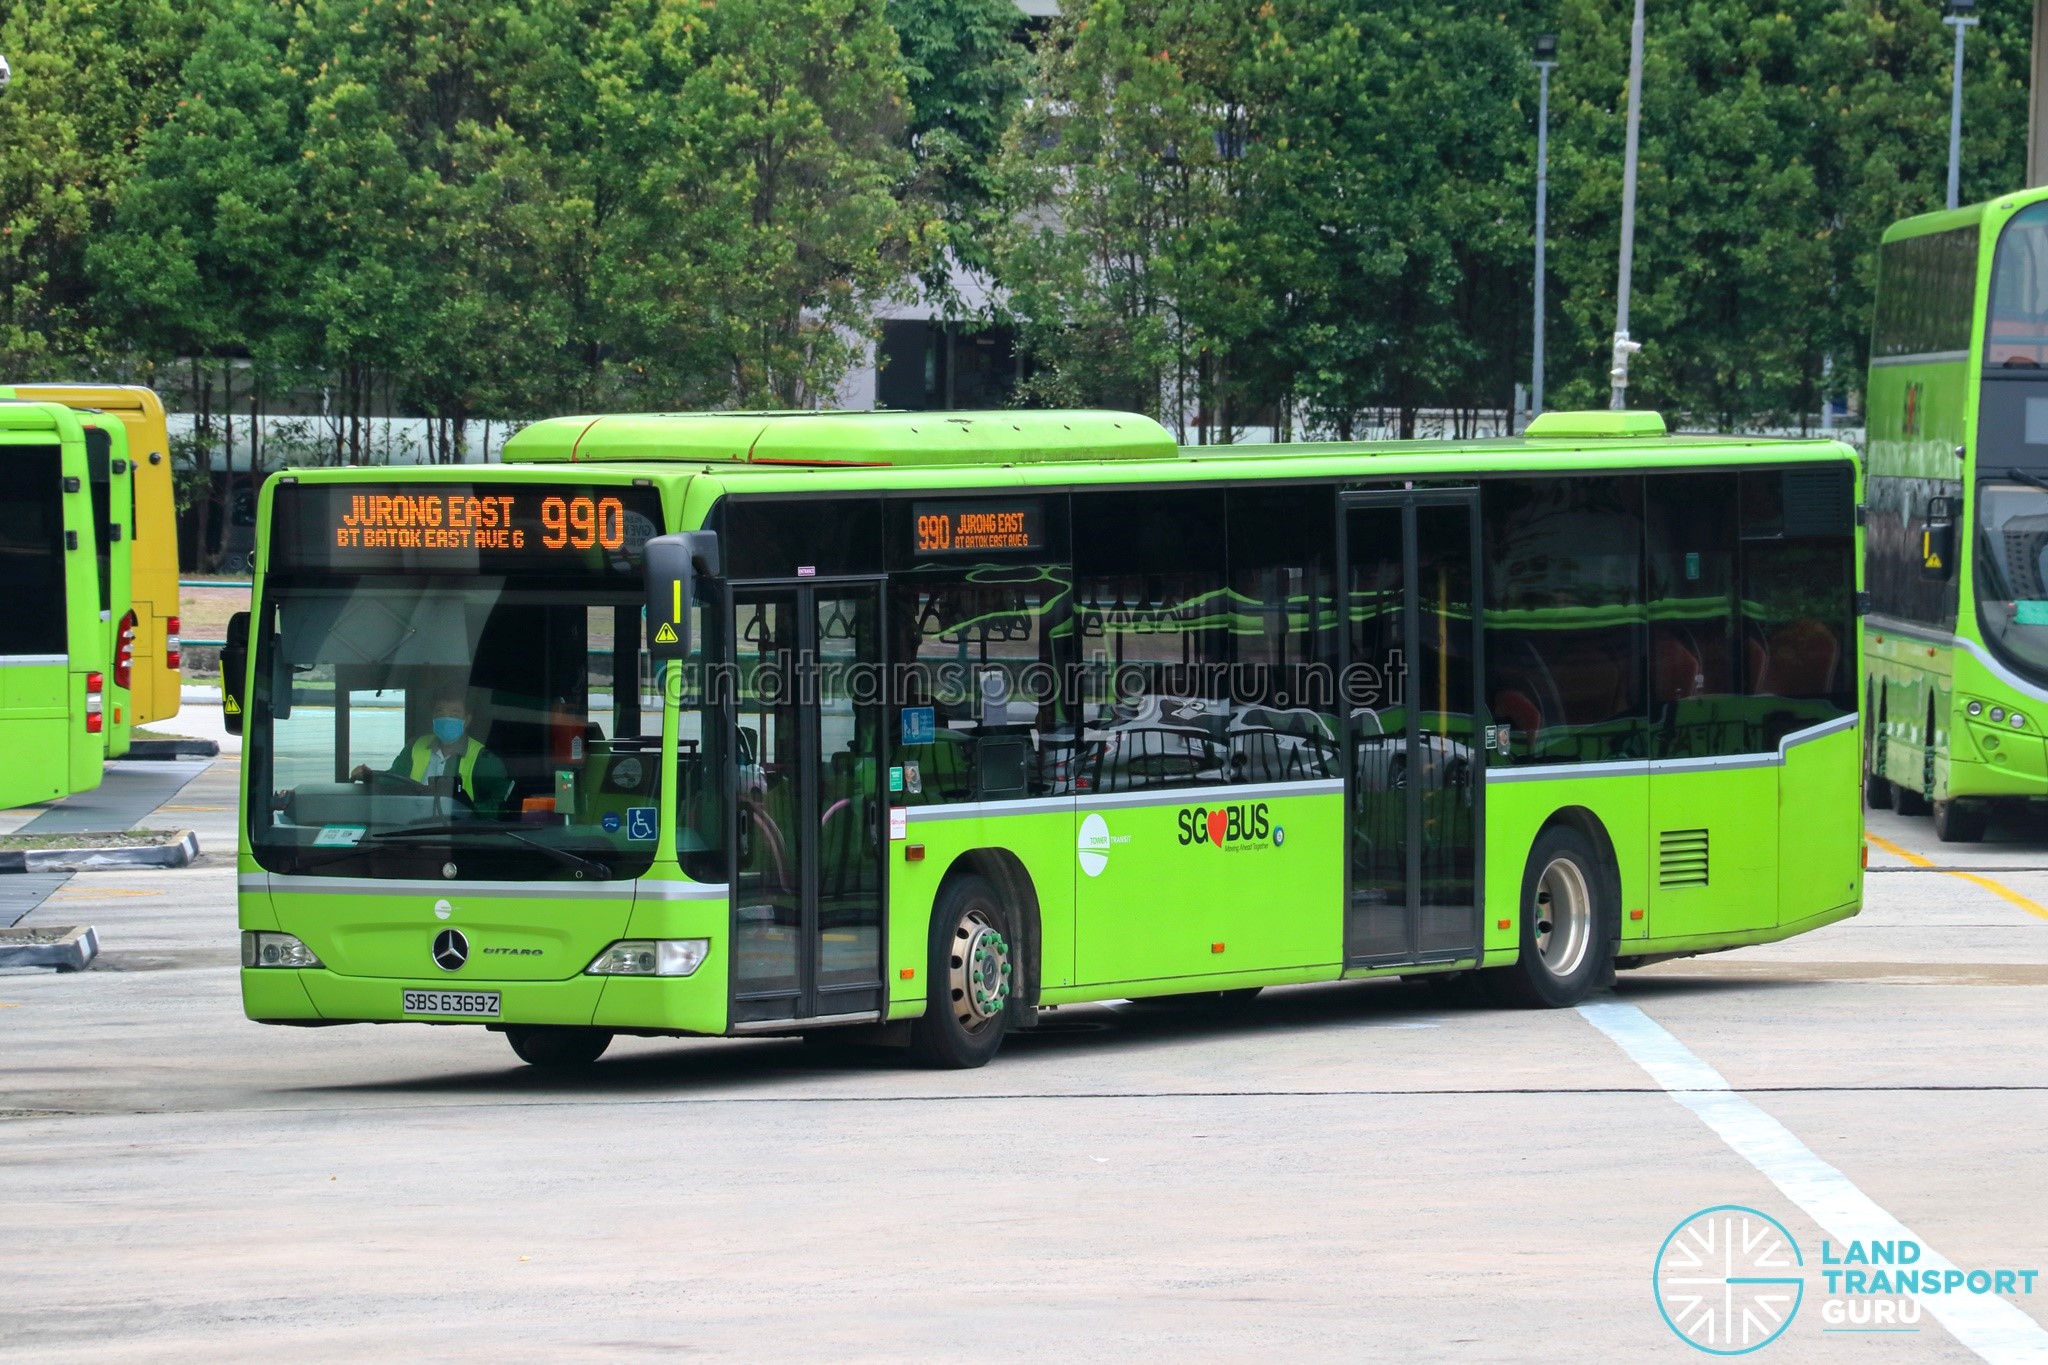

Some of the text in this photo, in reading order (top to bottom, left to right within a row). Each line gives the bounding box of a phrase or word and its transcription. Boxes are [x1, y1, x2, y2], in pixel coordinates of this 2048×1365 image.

[343, 495, 515, 527] JURONG EAST
[541, 497, 624, 549] 990
[918, 515, 950, 550] 990
[957, 512, 1024, 534] JURONG EAST
[337, 528, 524, 548] BT BATOK EAST AVE 6
[955, 533, 1028, 548] BT BATOK EAST AVE 6
[1090, 835, 1131, 845] TOWER TRANSIT
